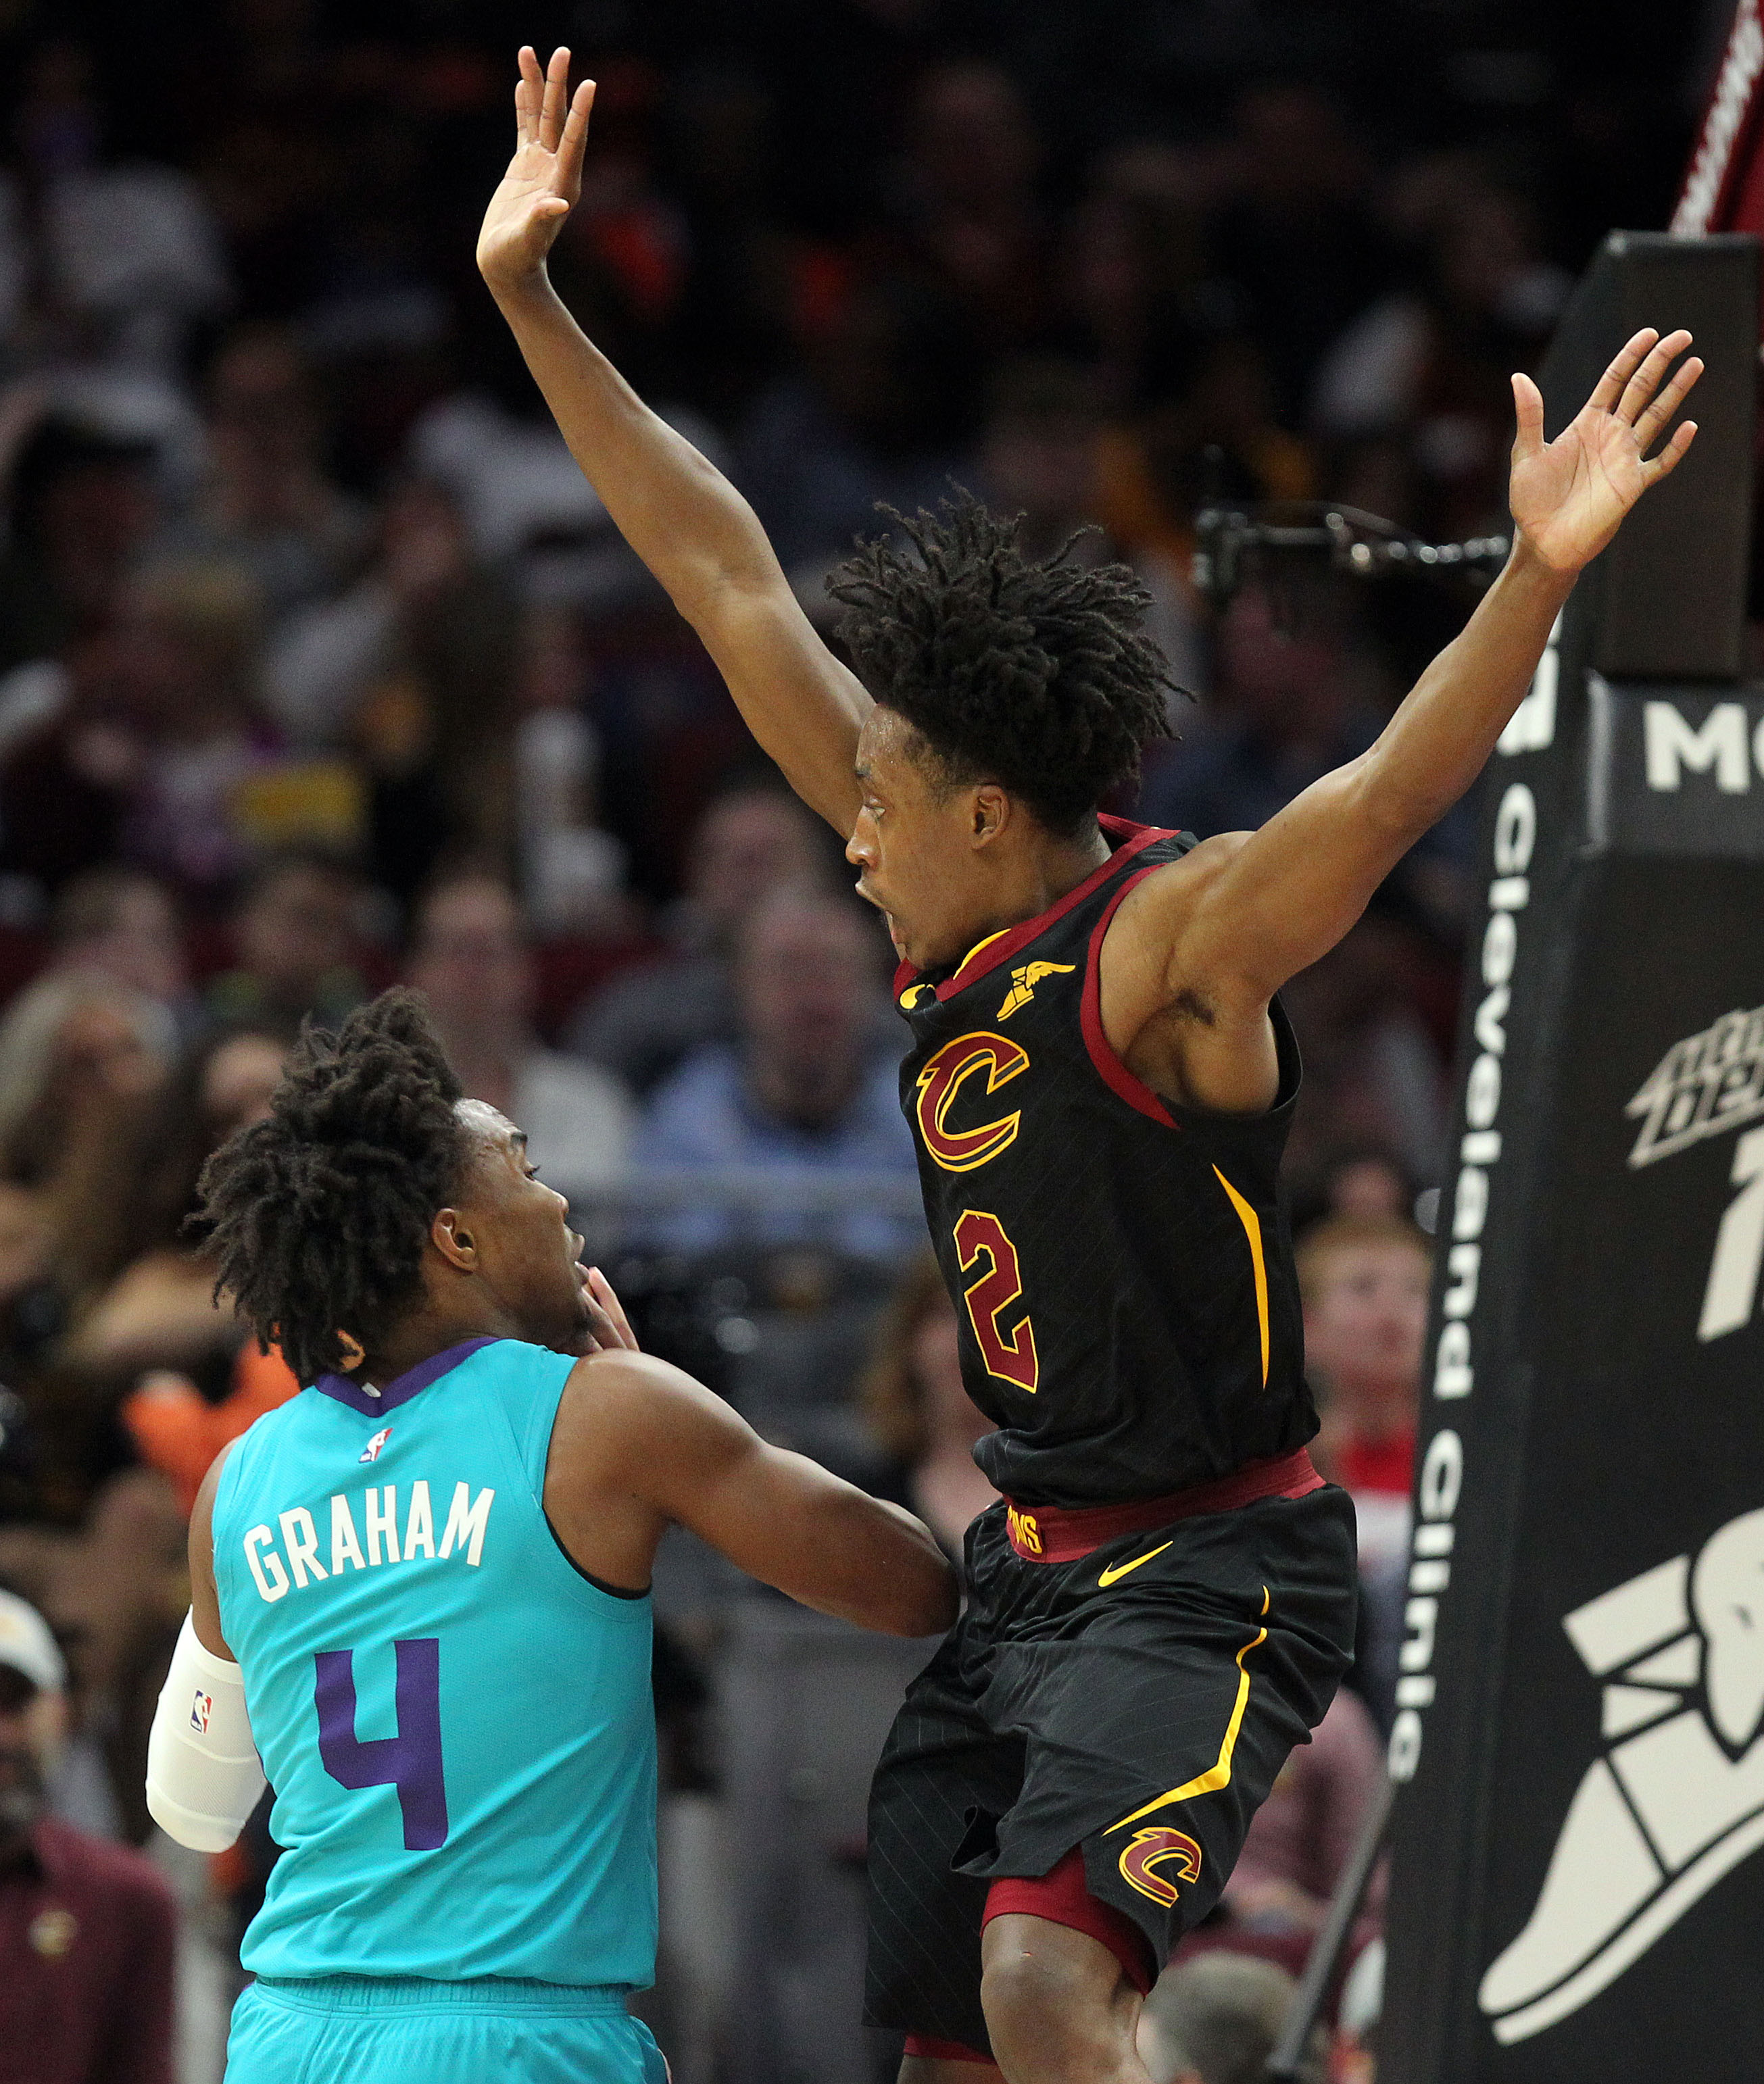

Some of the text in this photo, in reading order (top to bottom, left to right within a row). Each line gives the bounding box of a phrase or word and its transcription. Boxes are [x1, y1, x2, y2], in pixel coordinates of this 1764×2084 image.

[1644, 700, 1764, 795] M
[916, 1031, 1030, 1172] C
[953, 1209, 1039, 1394] 2
[243, 1480, 495, 1603] GRAHAM
[1388, 1429, 1463, 1784] Clinic
[314, 1638, 449, 1851] 4
